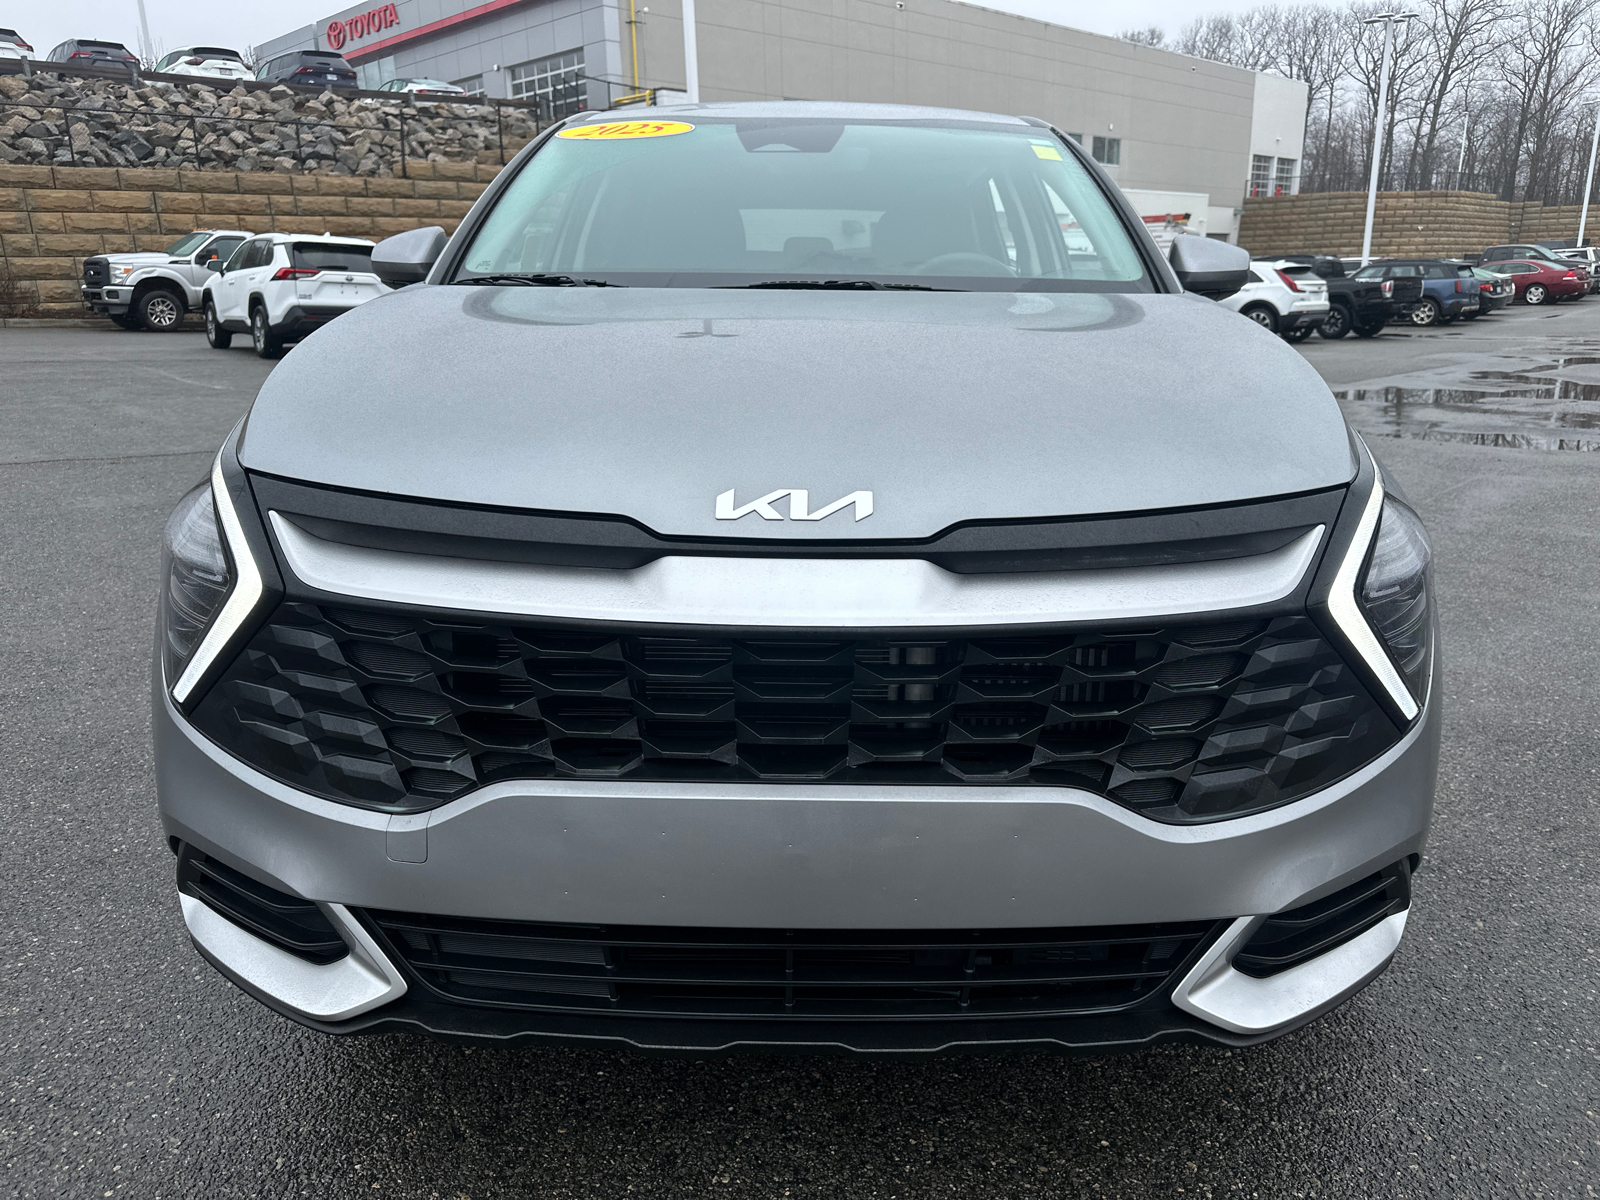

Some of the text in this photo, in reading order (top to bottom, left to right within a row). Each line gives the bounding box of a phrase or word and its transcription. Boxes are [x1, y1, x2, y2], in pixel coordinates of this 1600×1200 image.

[344, 2, 399, 41] TOYOTA
[573, 122, 675, 137] 2025
[715, 488, 874, 523] KIA
